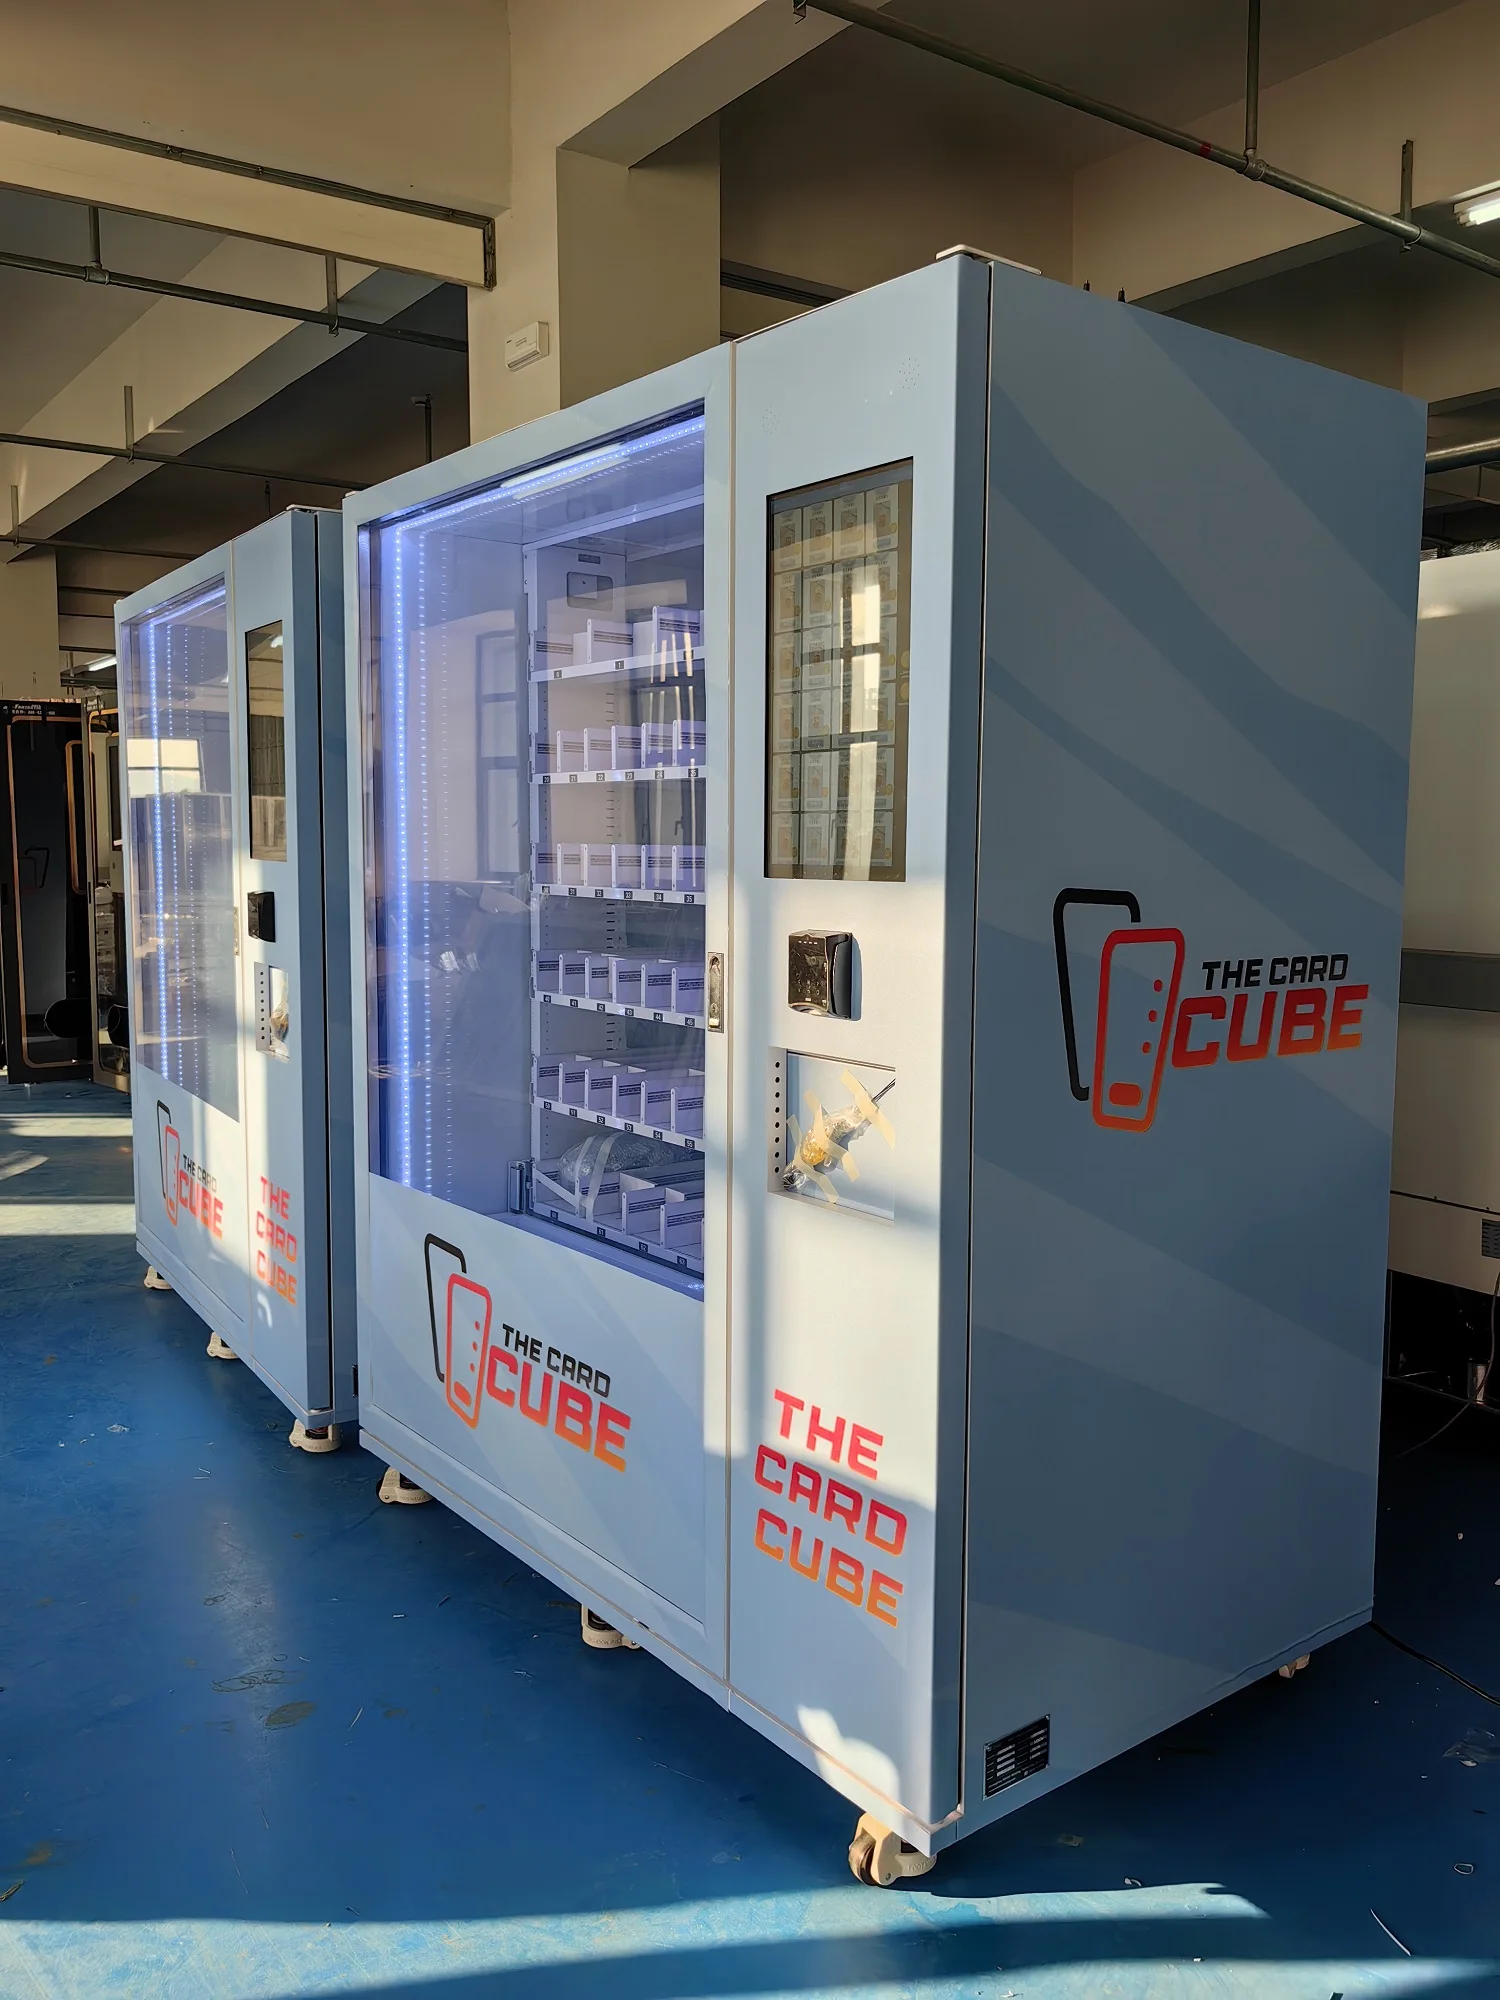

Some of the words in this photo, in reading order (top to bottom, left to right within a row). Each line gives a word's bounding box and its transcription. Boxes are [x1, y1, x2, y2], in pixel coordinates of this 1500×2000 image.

[1201, 958, 1264, 991] THE
[1268, 953, 1349, 986] CARD
[1171, 984, 1369, 1069] CUBE
[178, 1168, 224, 1240] CUBE
[182, 1154, 197, 1177] THE
[197, 1165, 217, 1193] CARD
[260, 1175, 291, 1221] THE
[256, 1210, 297, 1264] CARD
[256, 1250, 297, 1306] CUBE
[502, 1322, 543, 1364] THE
[546, 1346, 611, 1398] CARD
[486, 1344, 631, 1473] CUBE
[773, 1388, 884, 1481] THE
[754, 1443, 908, 1557] CARD
[754, 1507, 904, 1628] CUBE
